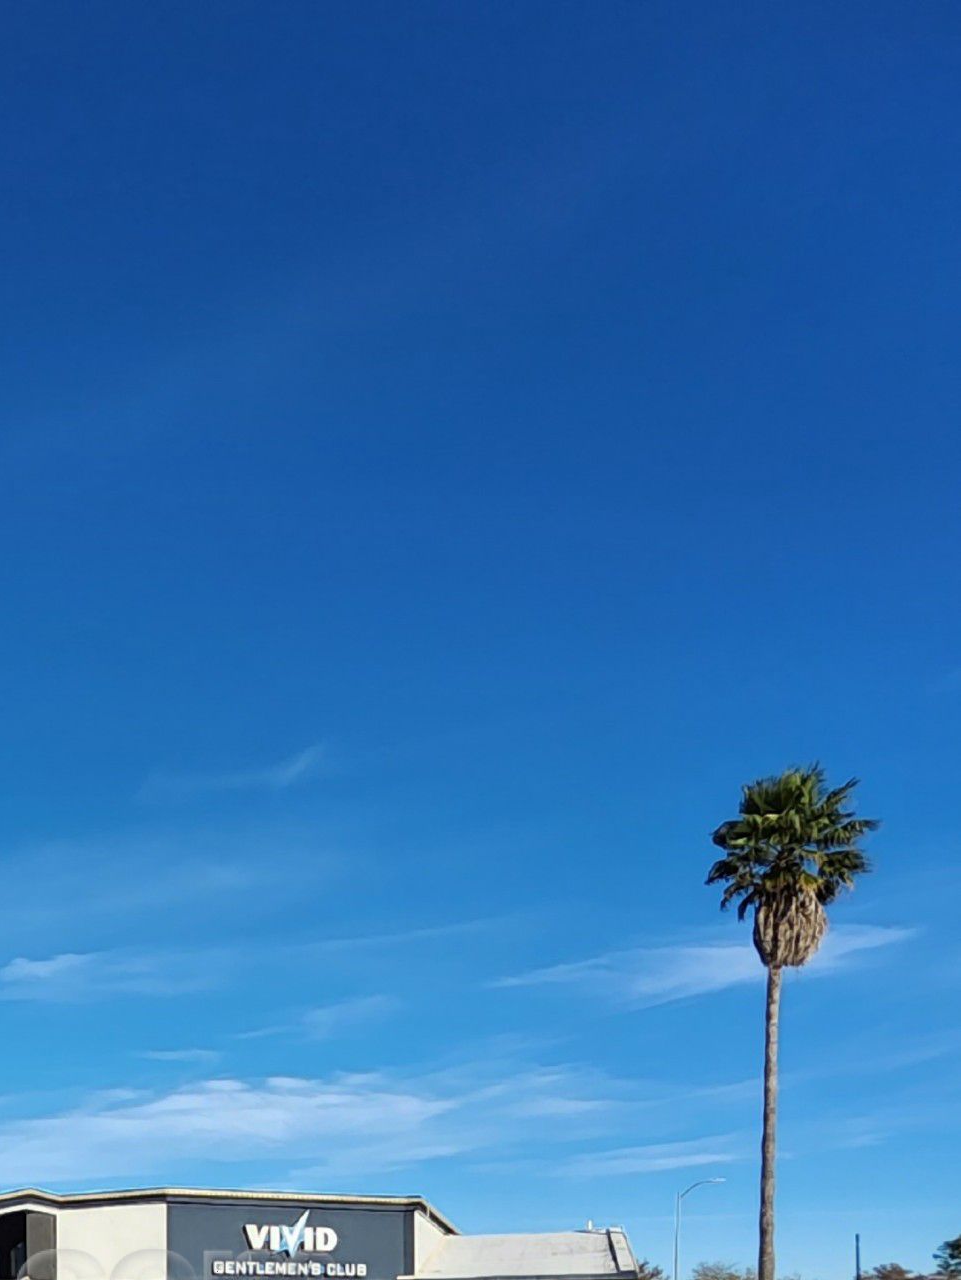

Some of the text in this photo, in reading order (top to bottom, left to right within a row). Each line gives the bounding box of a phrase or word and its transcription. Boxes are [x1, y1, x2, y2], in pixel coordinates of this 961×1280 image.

[245, 1209, 337, 1258] VIVID
[213, 1260, 367, 1276] GENTLEMEN'S CLUB
